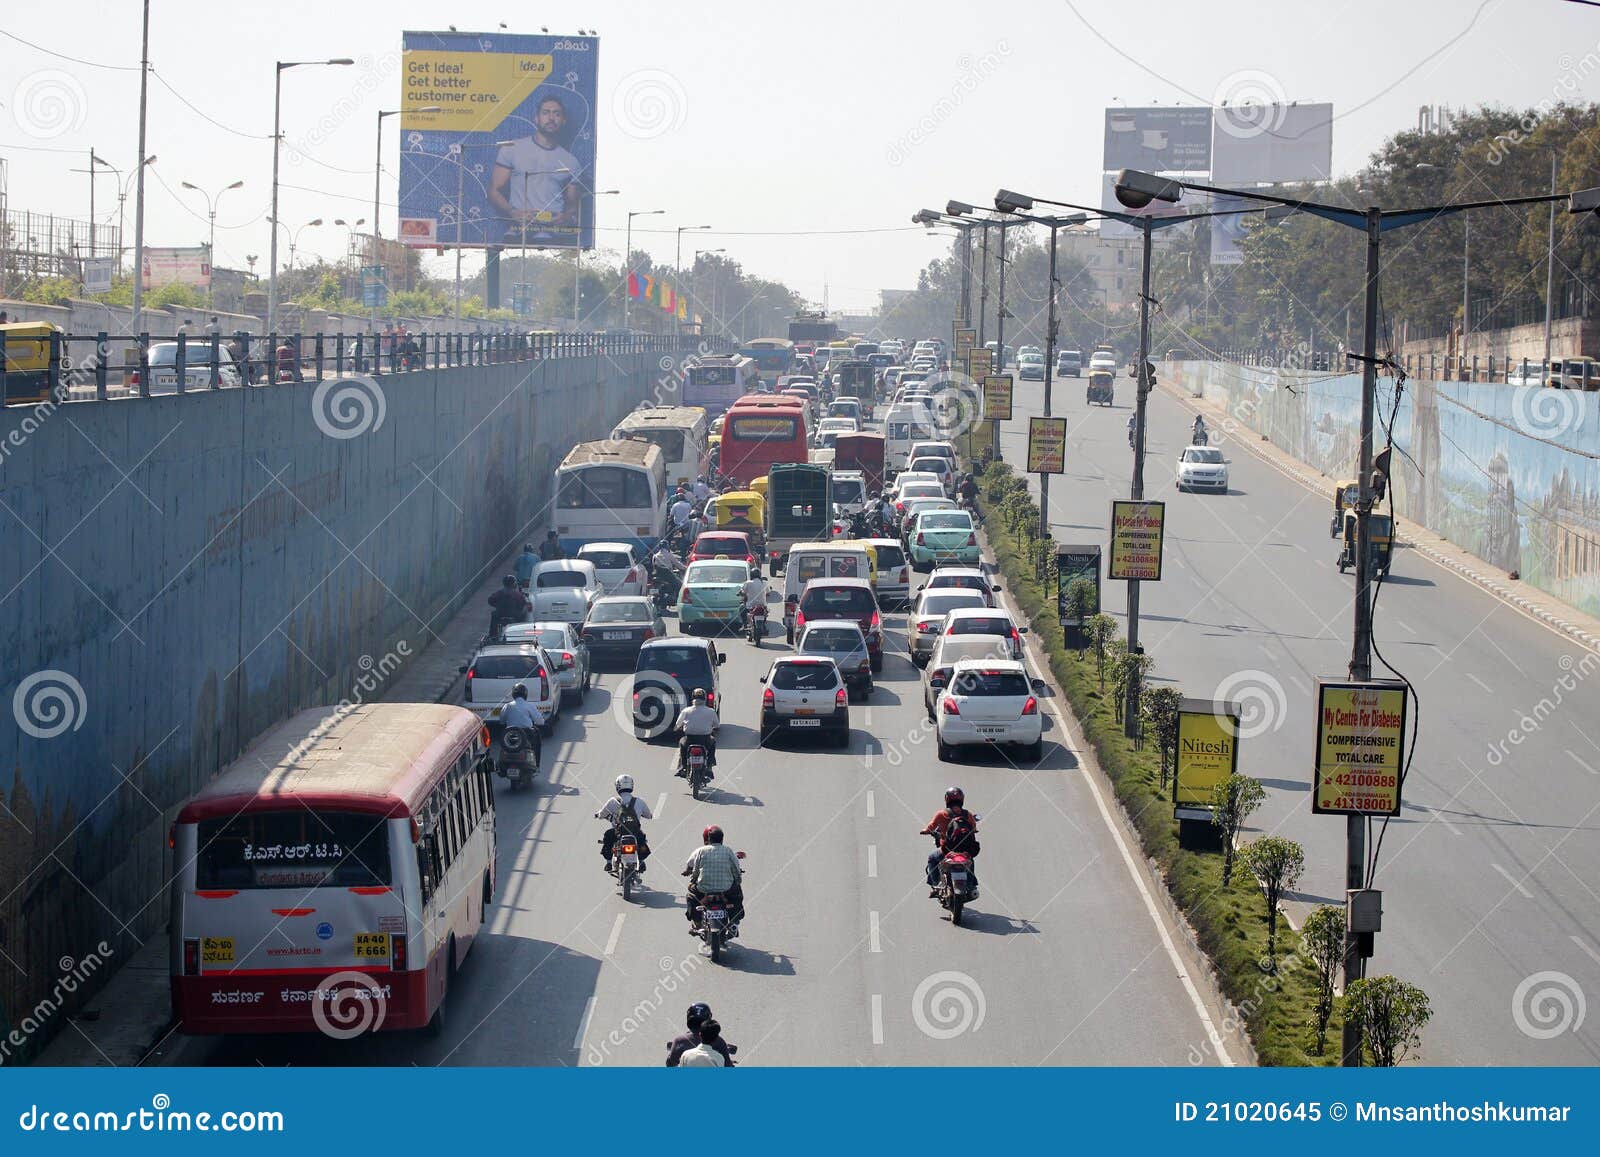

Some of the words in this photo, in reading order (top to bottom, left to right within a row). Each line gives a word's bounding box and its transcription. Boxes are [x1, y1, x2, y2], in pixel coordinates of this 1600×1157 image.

[408, 61, 430, 73] Get
[434, 62, 464, 74] Idea!
[407, 75, 429, 87] Get
[434, 76, 472, 88] better
[408, 90, 467, 102] customer
[470, 93, 500, 103] care.
[1325, 708, 1334, 730] My
[1335, 709, 1358, 726] Centre
[1360, 709, 1371, 727] For
[1371, 710, 1400, 728] Diabetes
[1183, 738, 1229, 753] Nitesh
[1327, 735, 1396, 747] COMPREHENSIVE
[1336, 752, 1360, 763] TOTAL
[1362, 753, 1385, 764] CARE
[1336, 774, 1395, 787] 42100888
[1335, 797, 1392, 810] 41138001
[357, 935, 369, 944] KA
[371, 935, 384, 944] 40
[366, 946, 386, 956] 666
